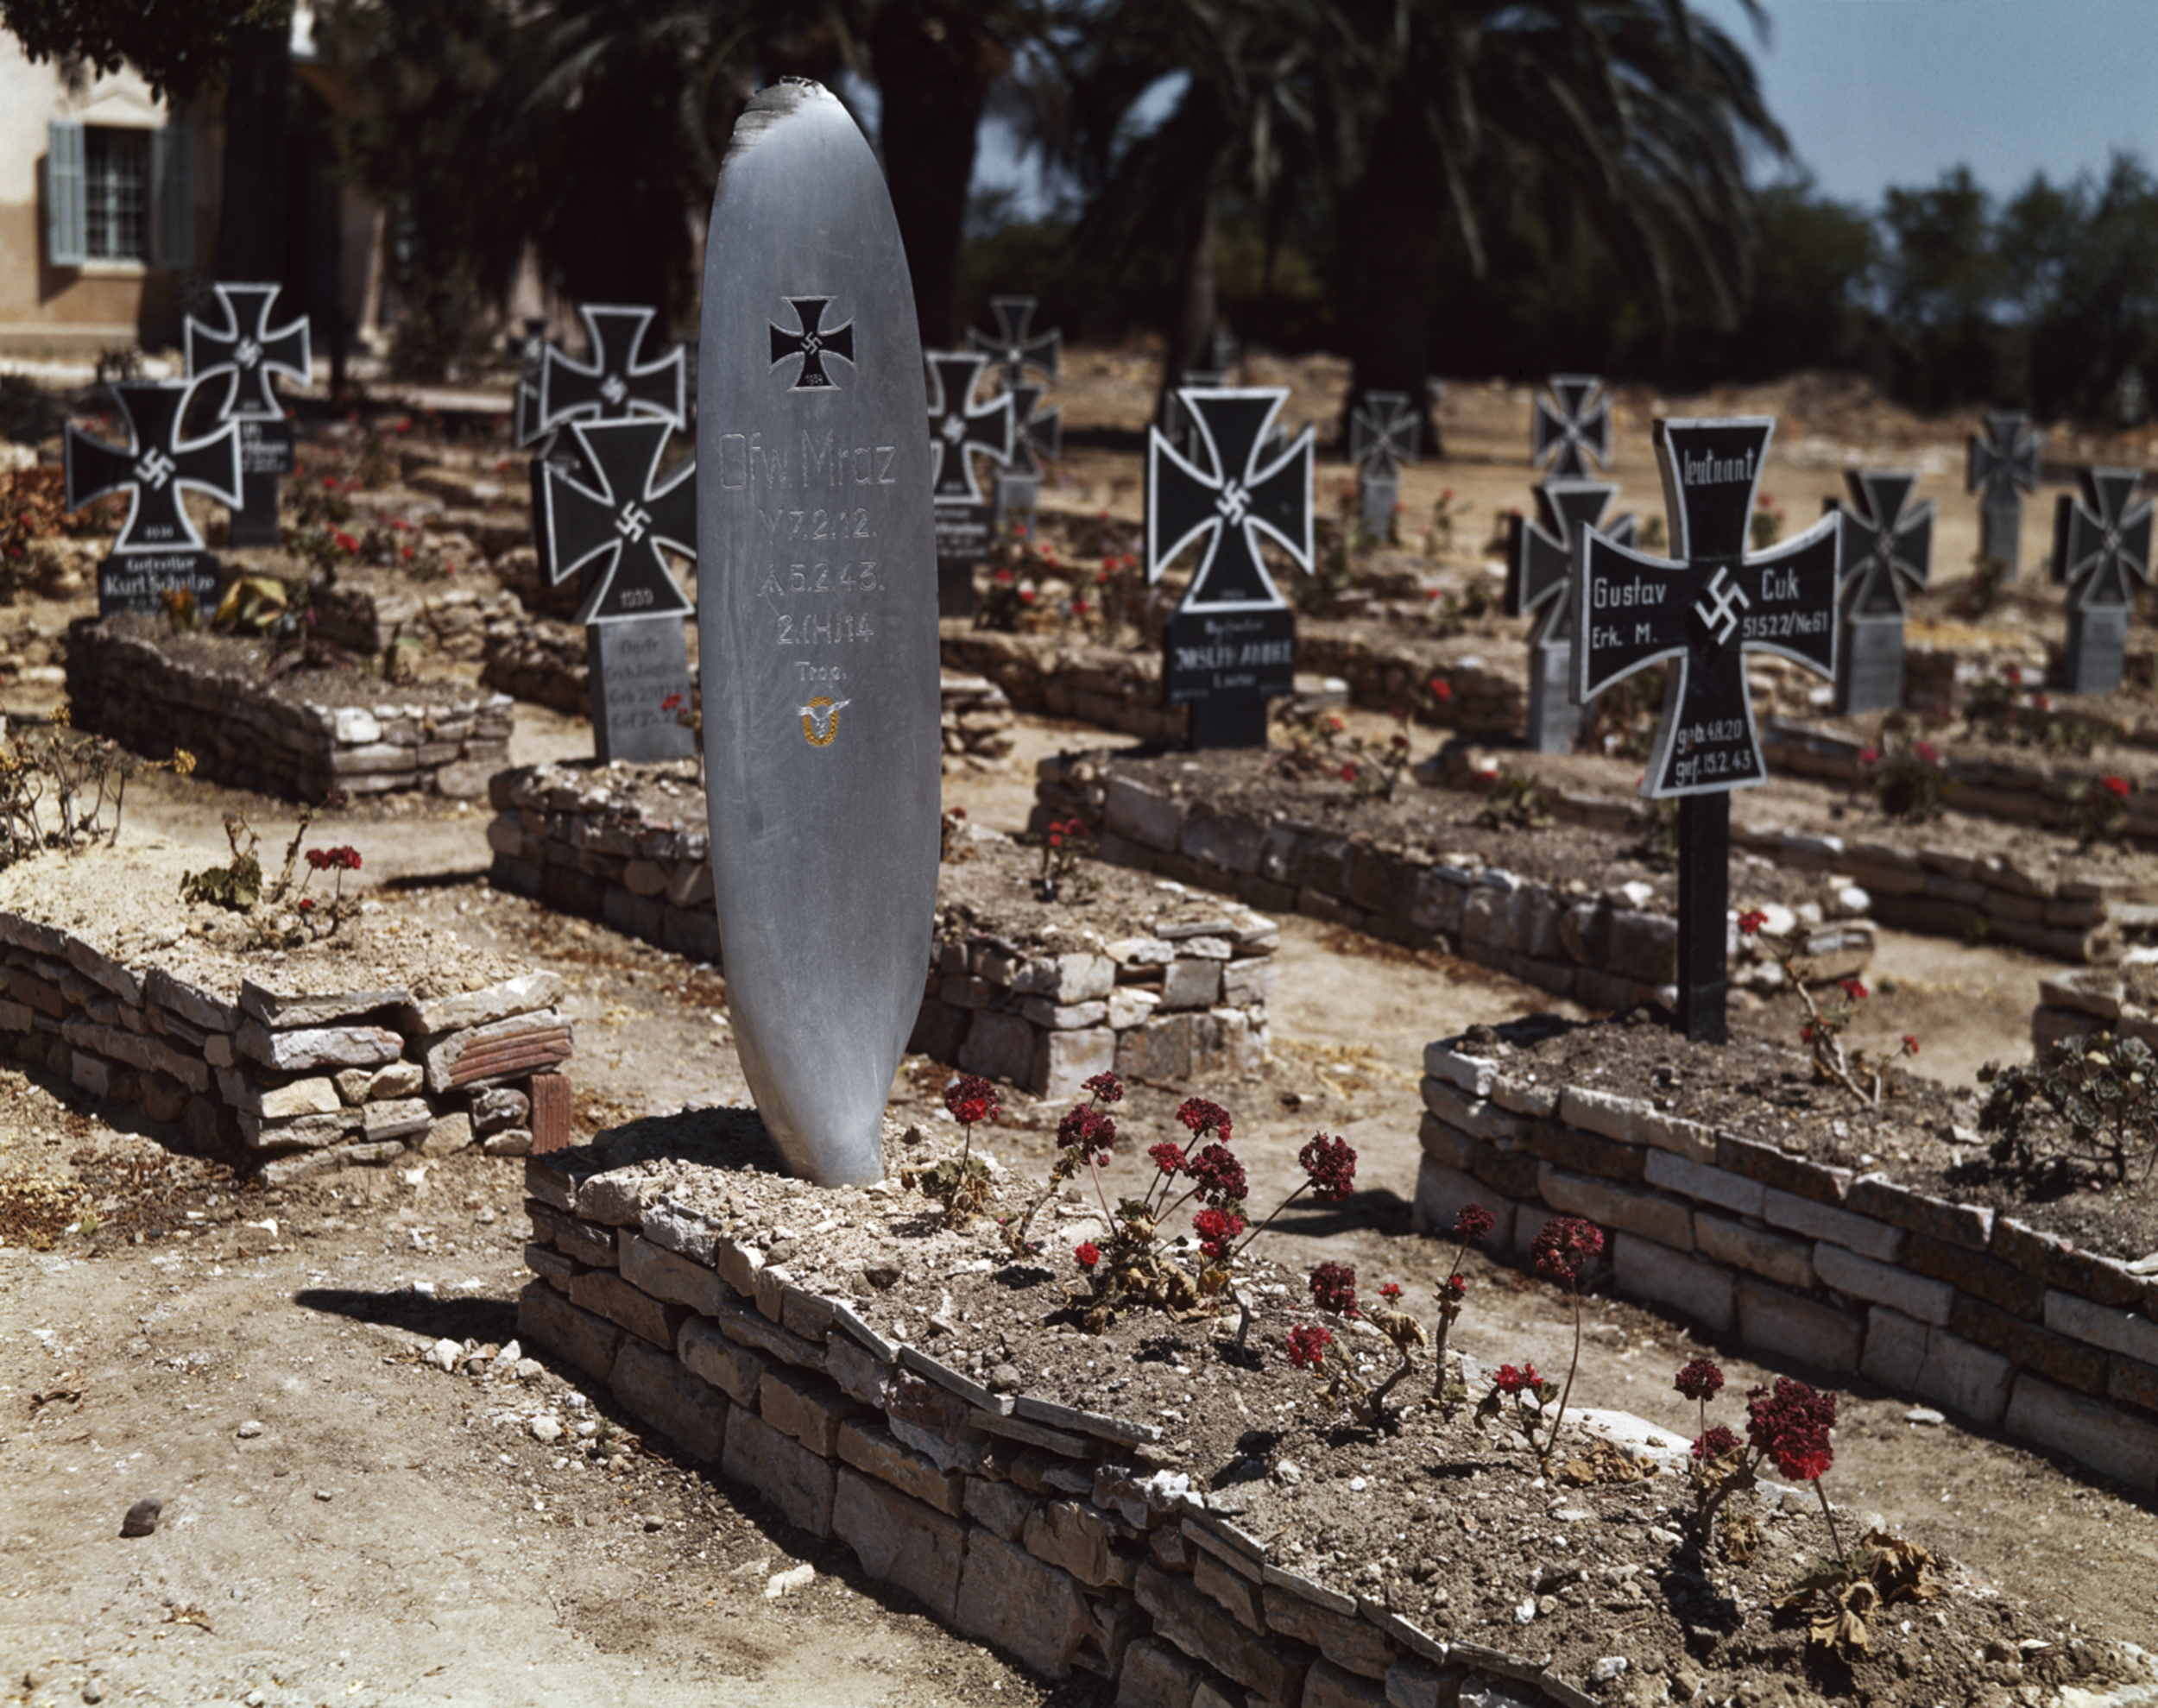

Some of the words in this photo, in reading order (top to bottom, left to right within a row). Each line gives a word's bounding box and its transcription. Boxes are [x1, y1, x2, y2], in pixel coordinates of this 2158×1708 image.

[801, 428, 897, 488] Mraz
[1593, 575, 1668, 609] Gustav
[1761, 567, 1801, 602] Cuk
[1592, 625, 1624, 650] Erk.
[1635, 621, 1658, 645] M.
